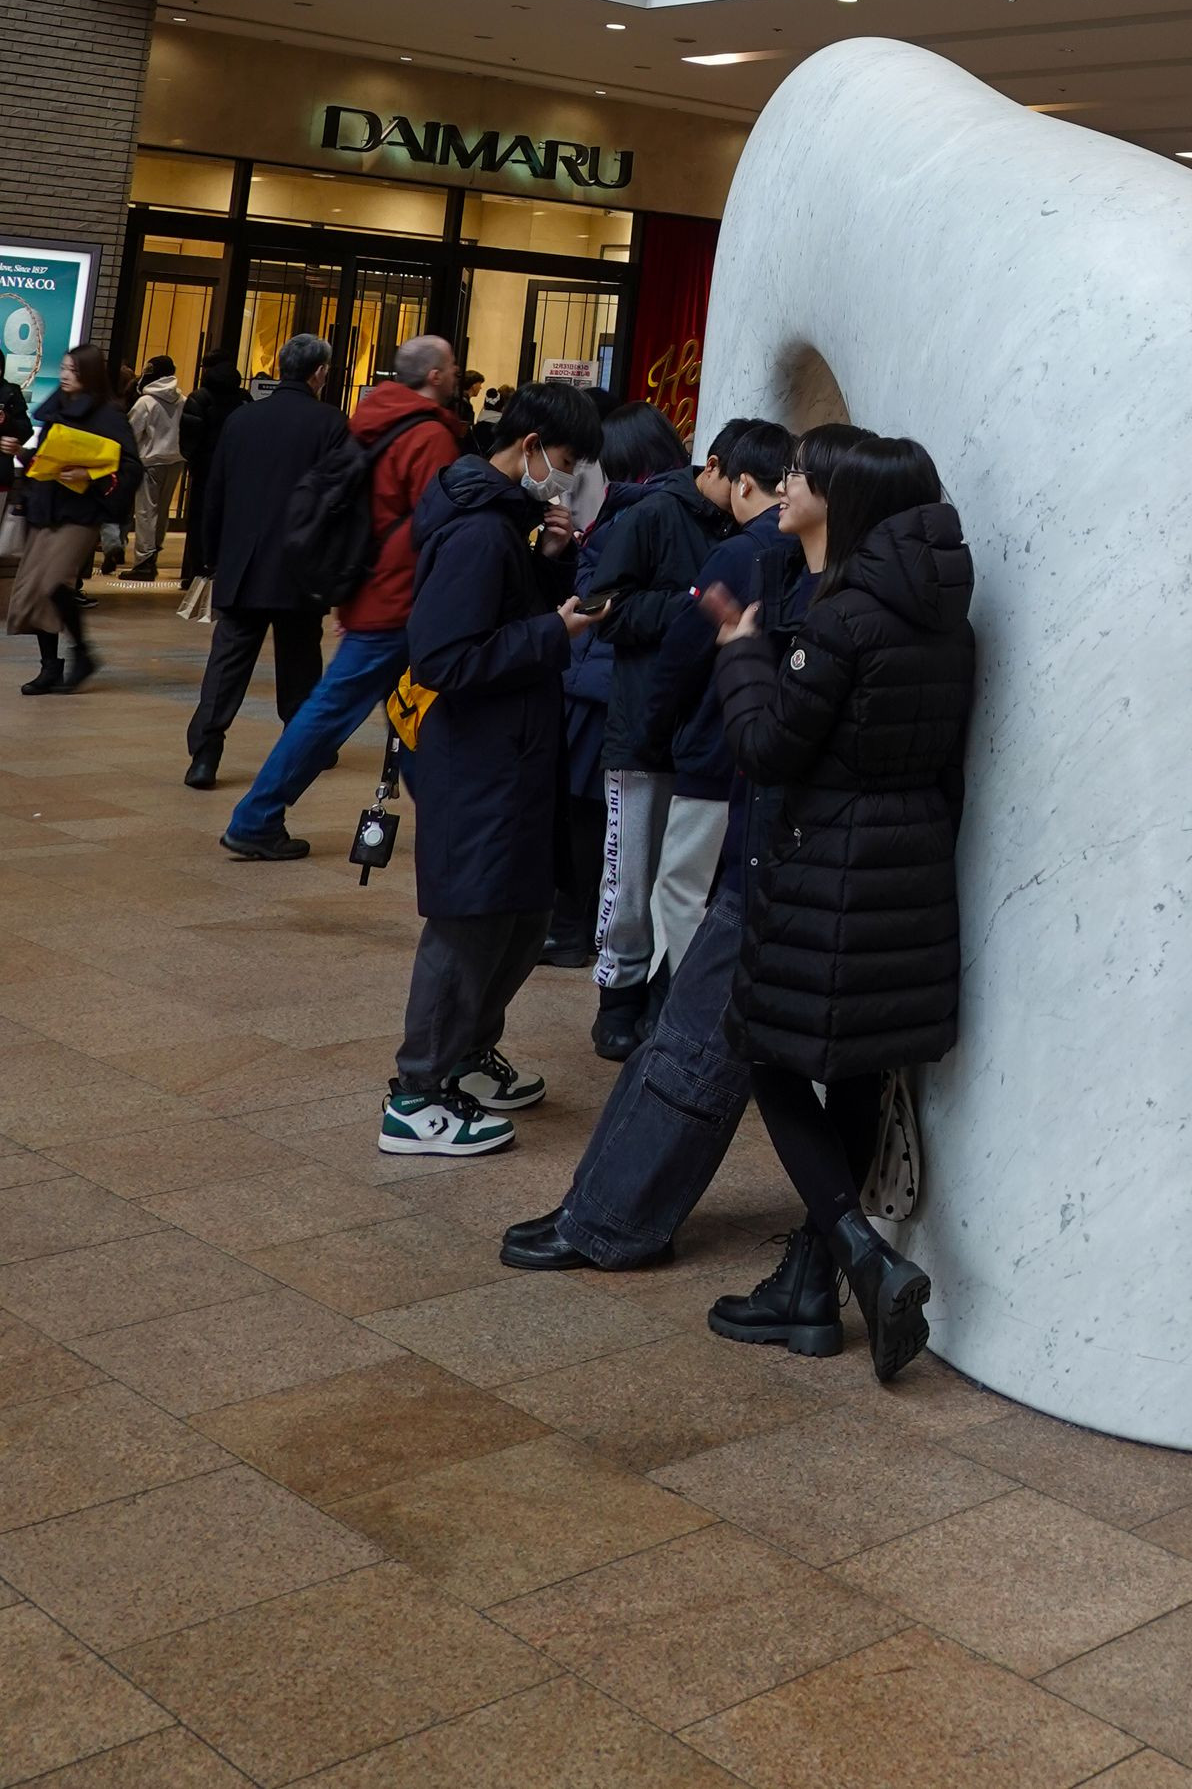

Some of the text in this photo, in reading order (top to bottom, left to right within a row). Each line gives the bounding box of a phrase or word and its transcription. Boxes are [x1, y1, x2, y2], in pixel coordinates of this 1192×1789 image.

[320, 104, 635, 190] DAIMARU
[31, 266, 48, 274] 1837
[610, 788, 619, 815] THE
[609, 818, 618, 827] 3
